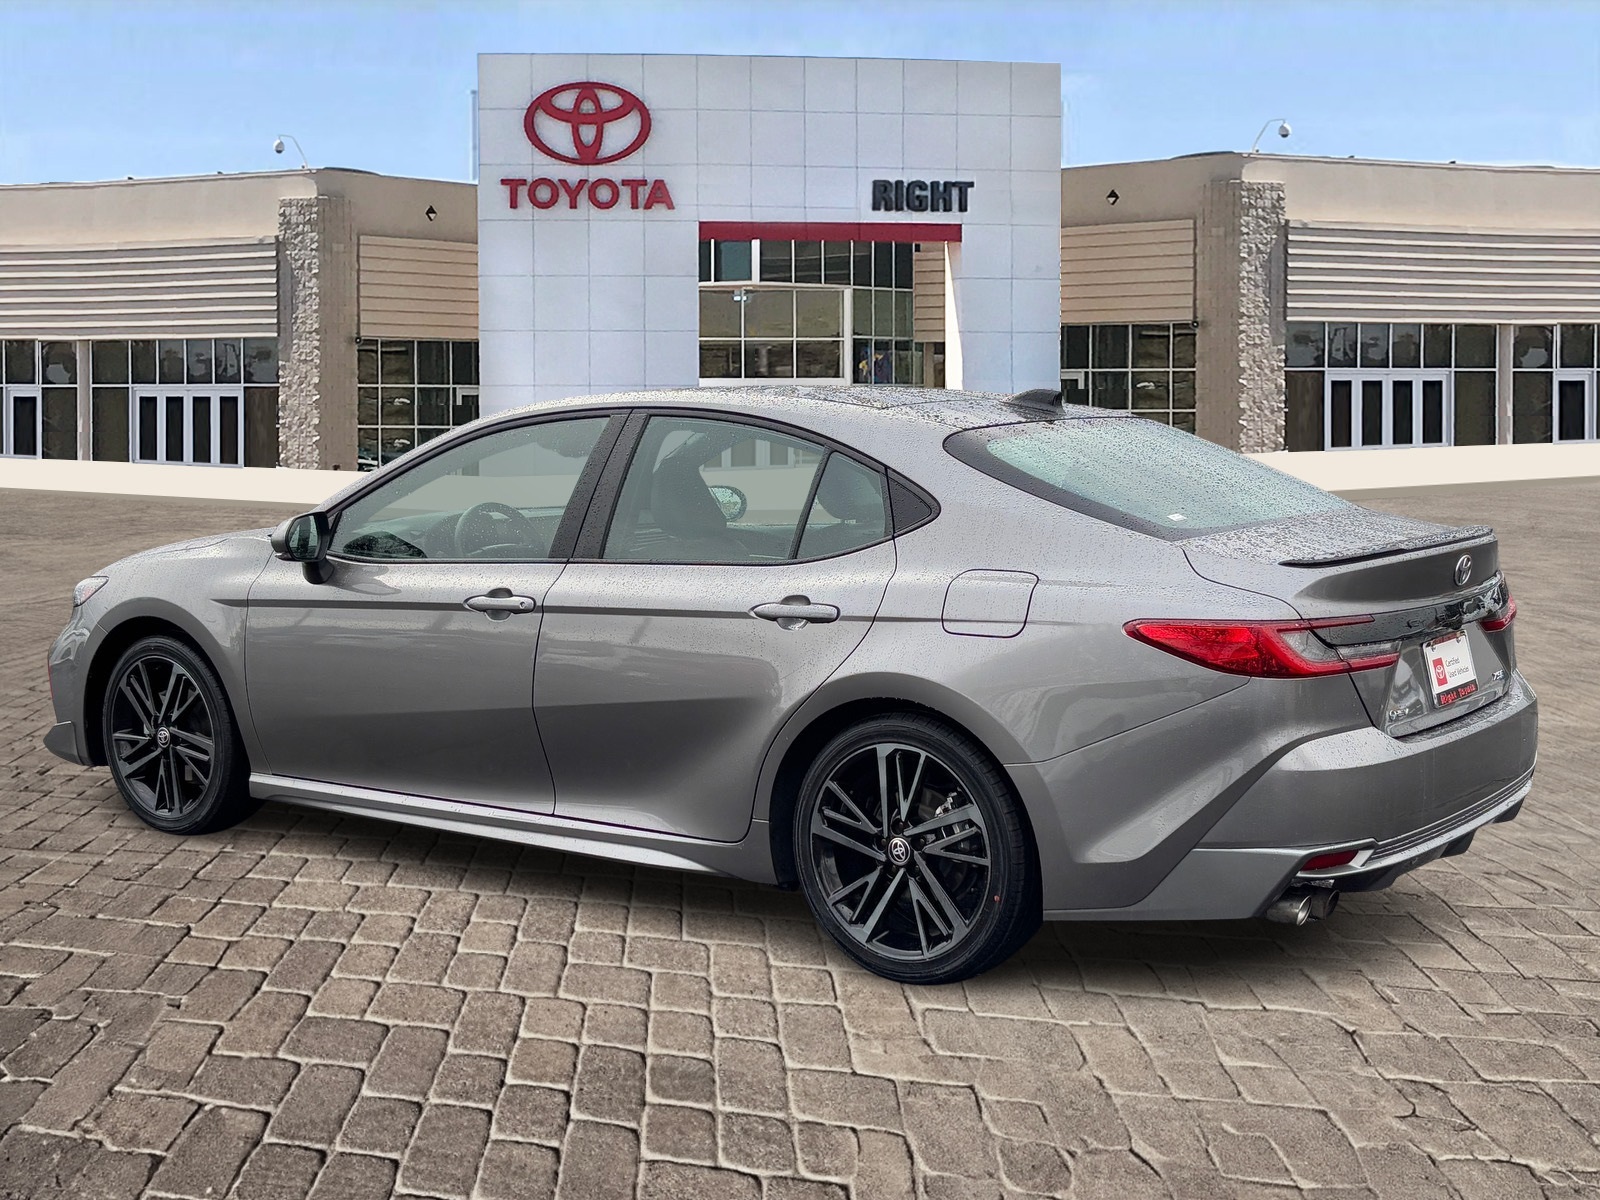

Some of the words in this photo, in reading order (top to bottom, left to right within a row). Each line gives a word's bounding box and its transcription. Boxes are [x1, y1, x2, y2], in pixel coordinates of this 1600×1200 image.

[501, 178, 675, 210] TOYOTA
[871, 179, 975, 213] RIGHT
[1440, 691, 1457, 704] Right
[1458, 684, 1476, 697] Toyota
